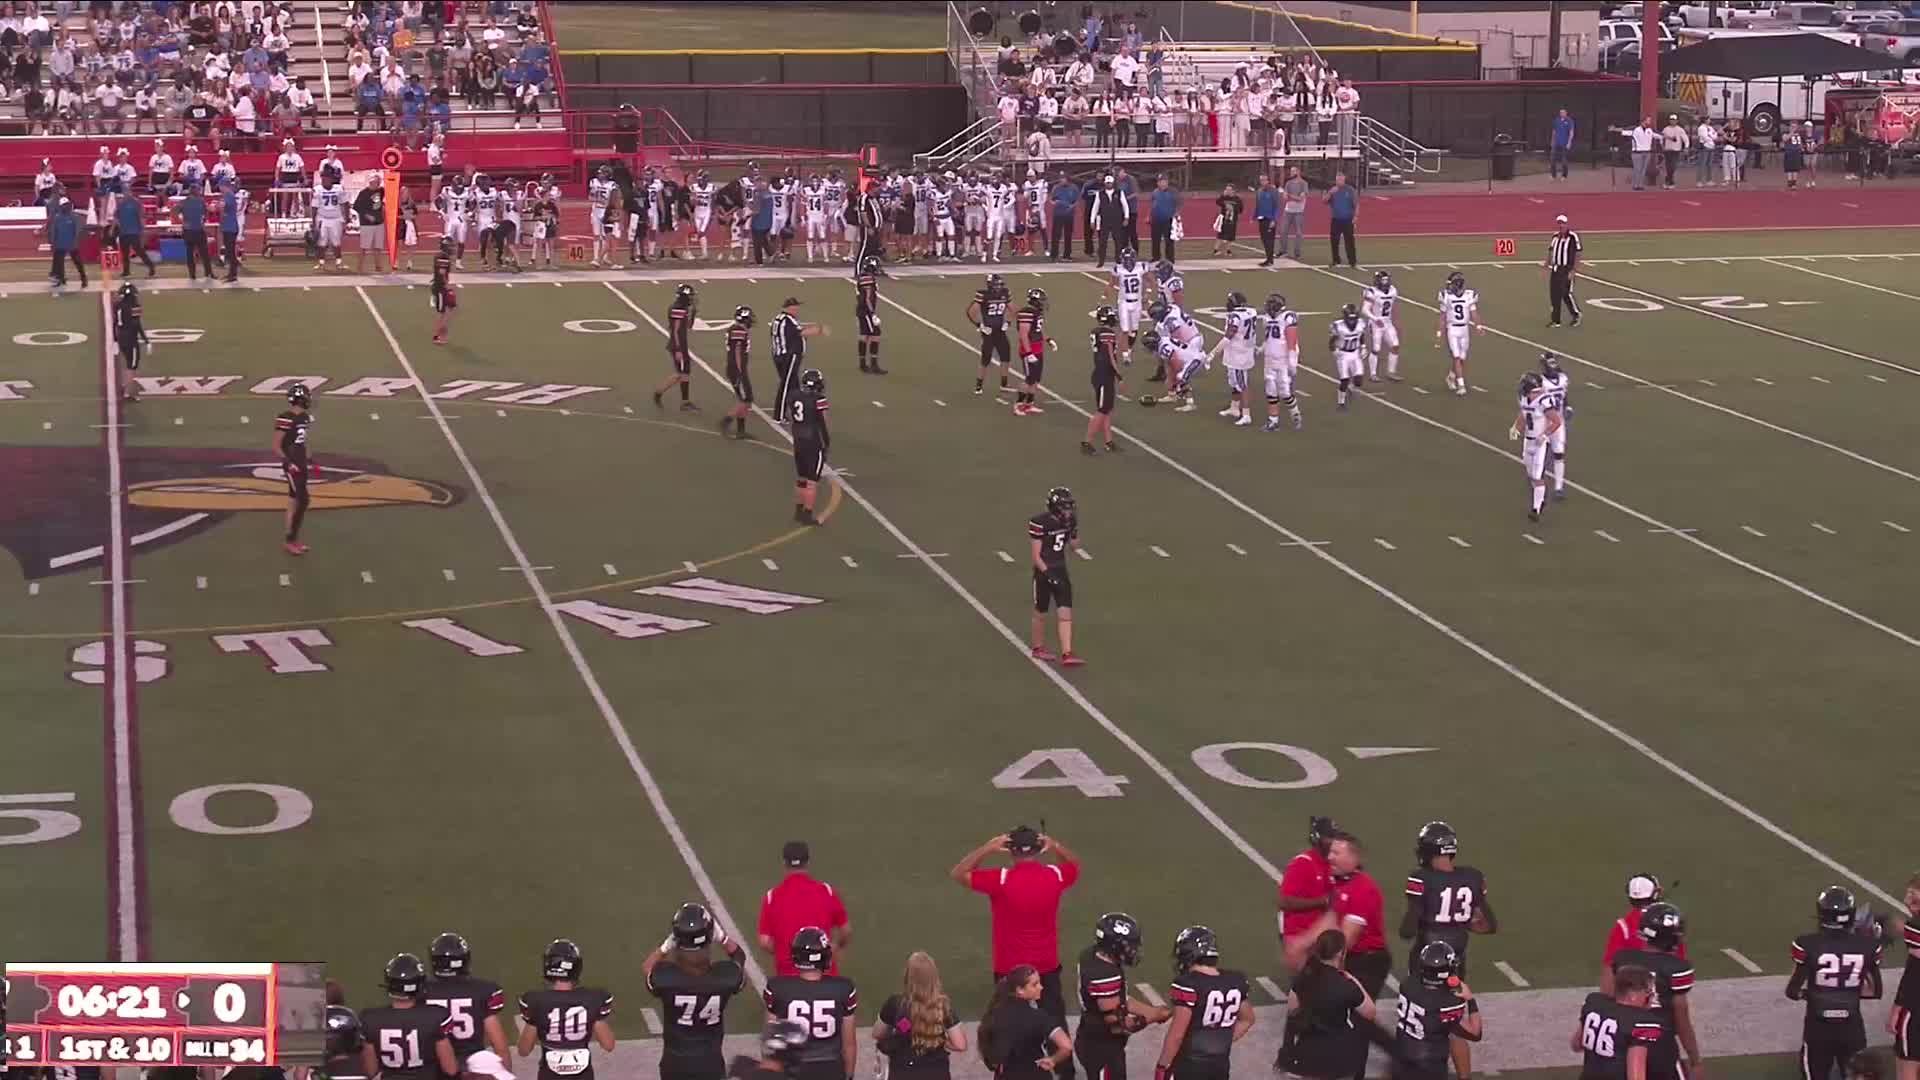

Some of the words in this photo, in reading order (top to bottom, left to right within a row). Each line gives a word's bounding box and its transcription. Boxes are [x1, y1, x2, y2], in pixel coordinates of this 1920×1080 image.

[993, 194, 1000, 208] 7
[569, 247, 583, 259] 40
[1499, 241, 1513, 254] 20
[105, 255, 119, 266] 50
[1123, 278, 1140, 294] 12
[1381, 300, 1391, 316] 2
[1454, 304, 1464, 320] 9
[133, 376, 613, 404] WORTH
[794, 401, 804, 421] 3
[1053, 534, 1065, 551] 5
[1434, 886, 1474, 923] 13
[1816, 953, 1865, 988] 27
[674, 995, 721, 1027] 74
[787, 999, 837, 1039] 65
[1202, 988, 1242, 1028] 62
[546, 1005, 588, 1042] 10
[1583, 1011, 1618, 1057] 66
[380, 1027, 424, 1069] 51
